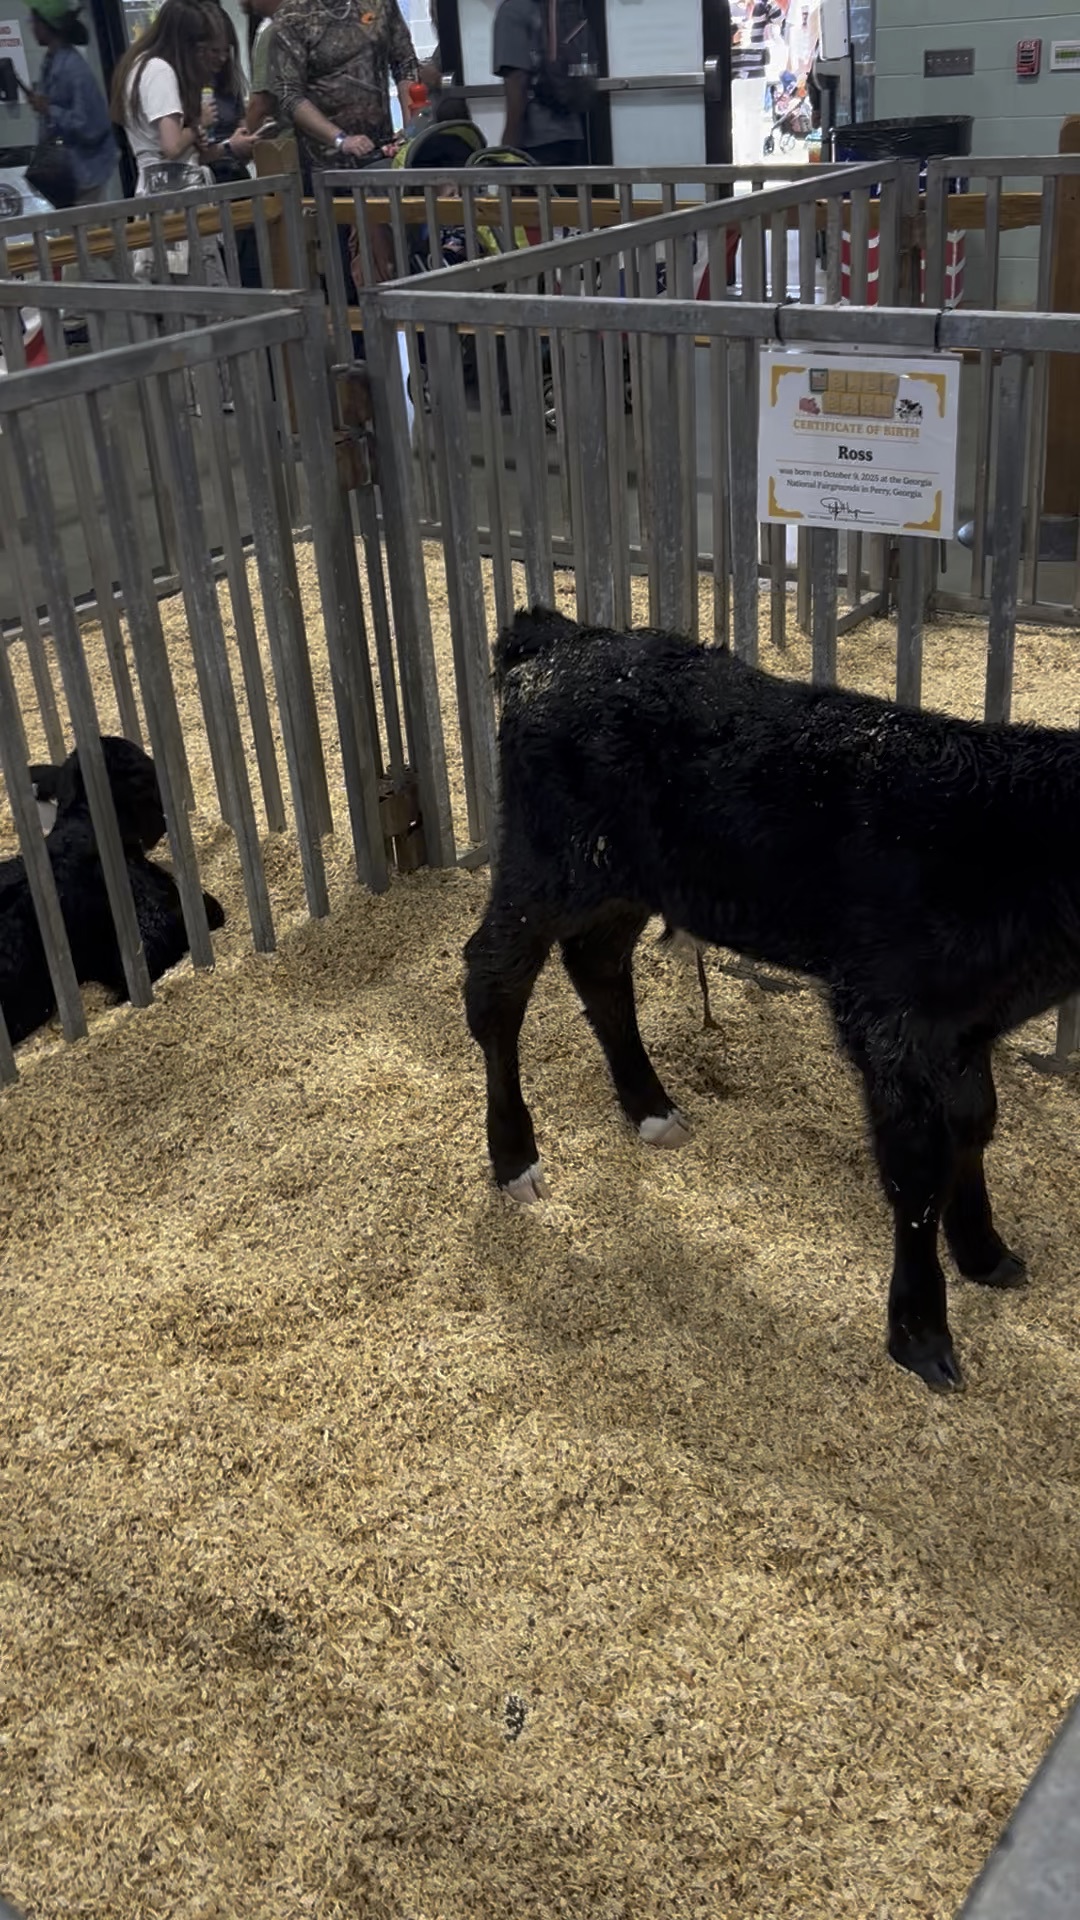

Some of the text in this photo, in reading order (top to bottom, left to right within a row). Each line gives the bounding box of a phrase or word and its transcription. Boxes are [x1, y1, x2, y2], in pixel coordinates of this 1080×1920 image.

[794, 420, 920, 438] CERTIFICATE OF BIRTH
[838, 445, 873, 461] Ross
[794, 468, 811, 476] born
[823, 470, 851, 480] October
[861, 472, 879, 482] 2025
[881, 475, 888, 483] at
[890, 476, 901, 484] the
[903, 477, 932, 488] Georgia
[786, 479, 816, 489] National
[817, 481, 860, 492] Fairgrounds
[862, 485, 869, 493] in
[870, 485, 892, 496] Perry,
